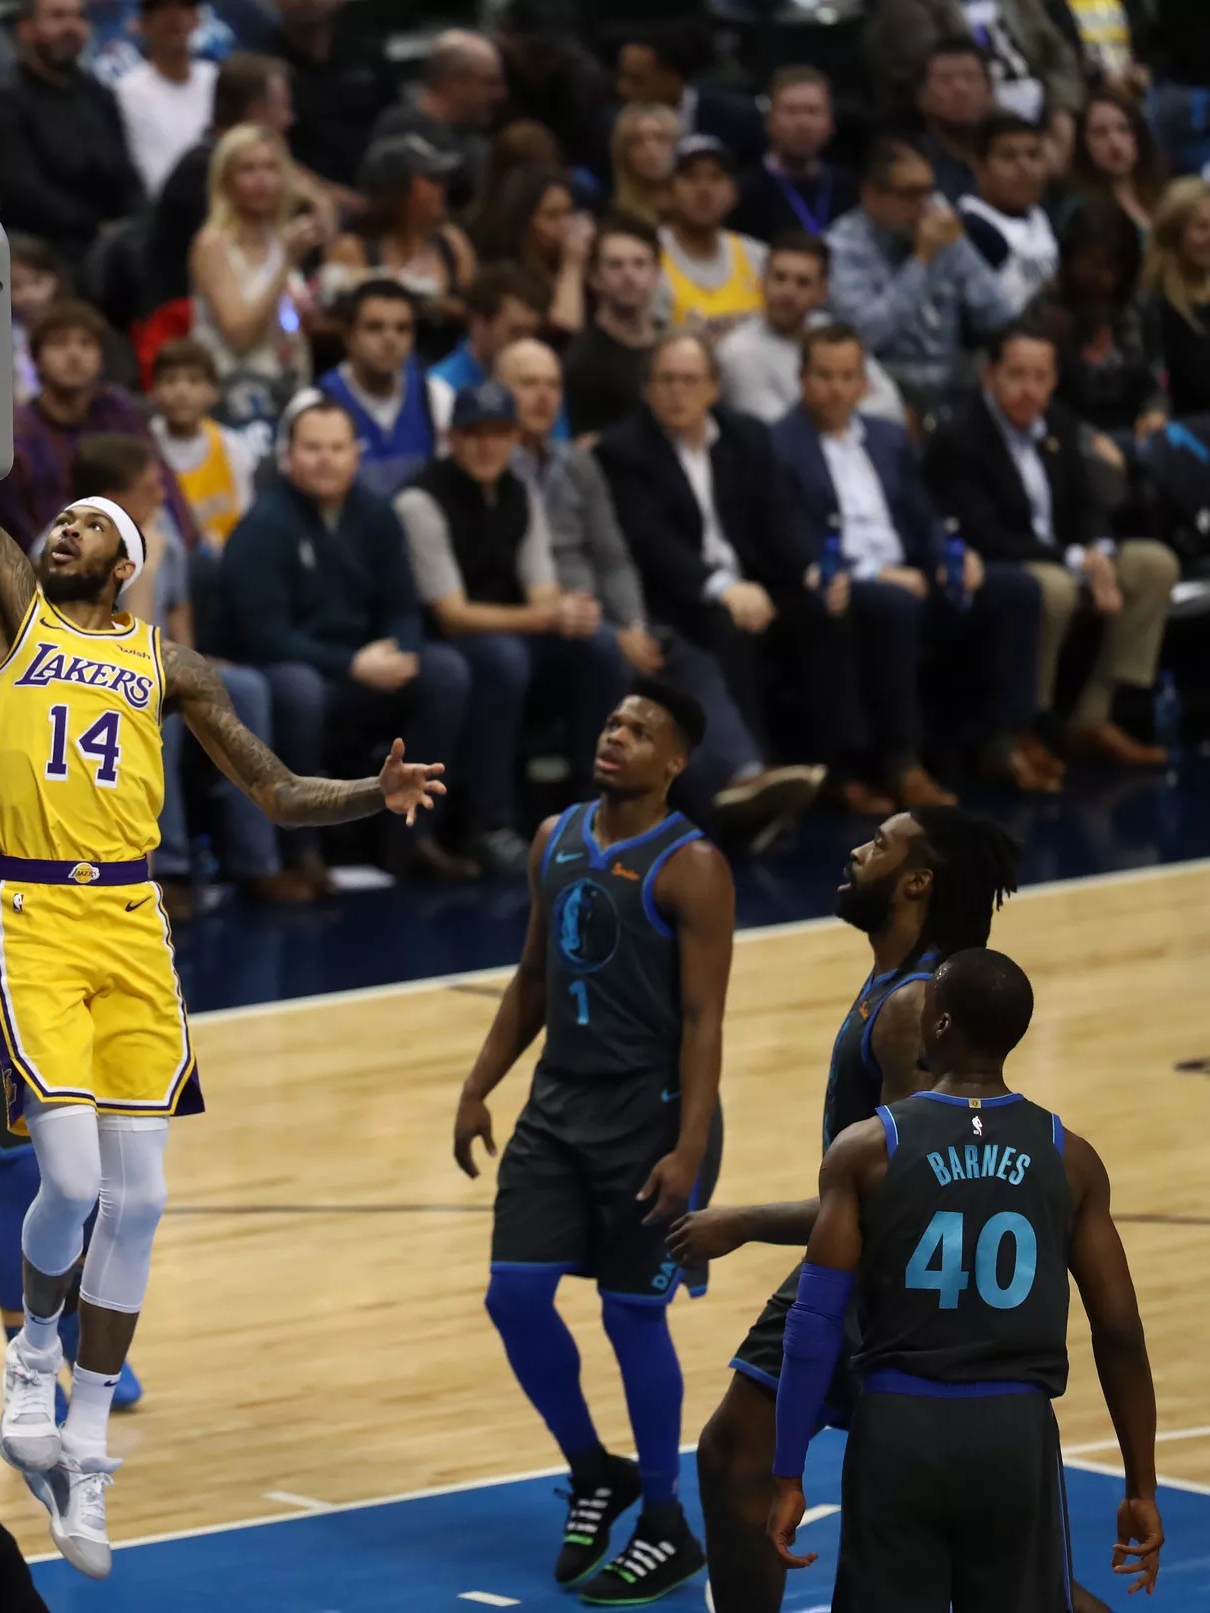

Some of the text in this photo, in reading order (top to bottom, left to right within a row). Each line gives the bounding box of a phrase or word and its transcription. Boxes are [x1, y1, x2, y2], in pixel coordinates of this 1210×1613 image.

[13, 641, 155, 709] LAKERS
[45, 704, 121, 787] 14
[568, 980, 590, 1025] 1
[926, 1144, 1032, 1187] BARNES
[905, 1210, 1038, 1310] 40
